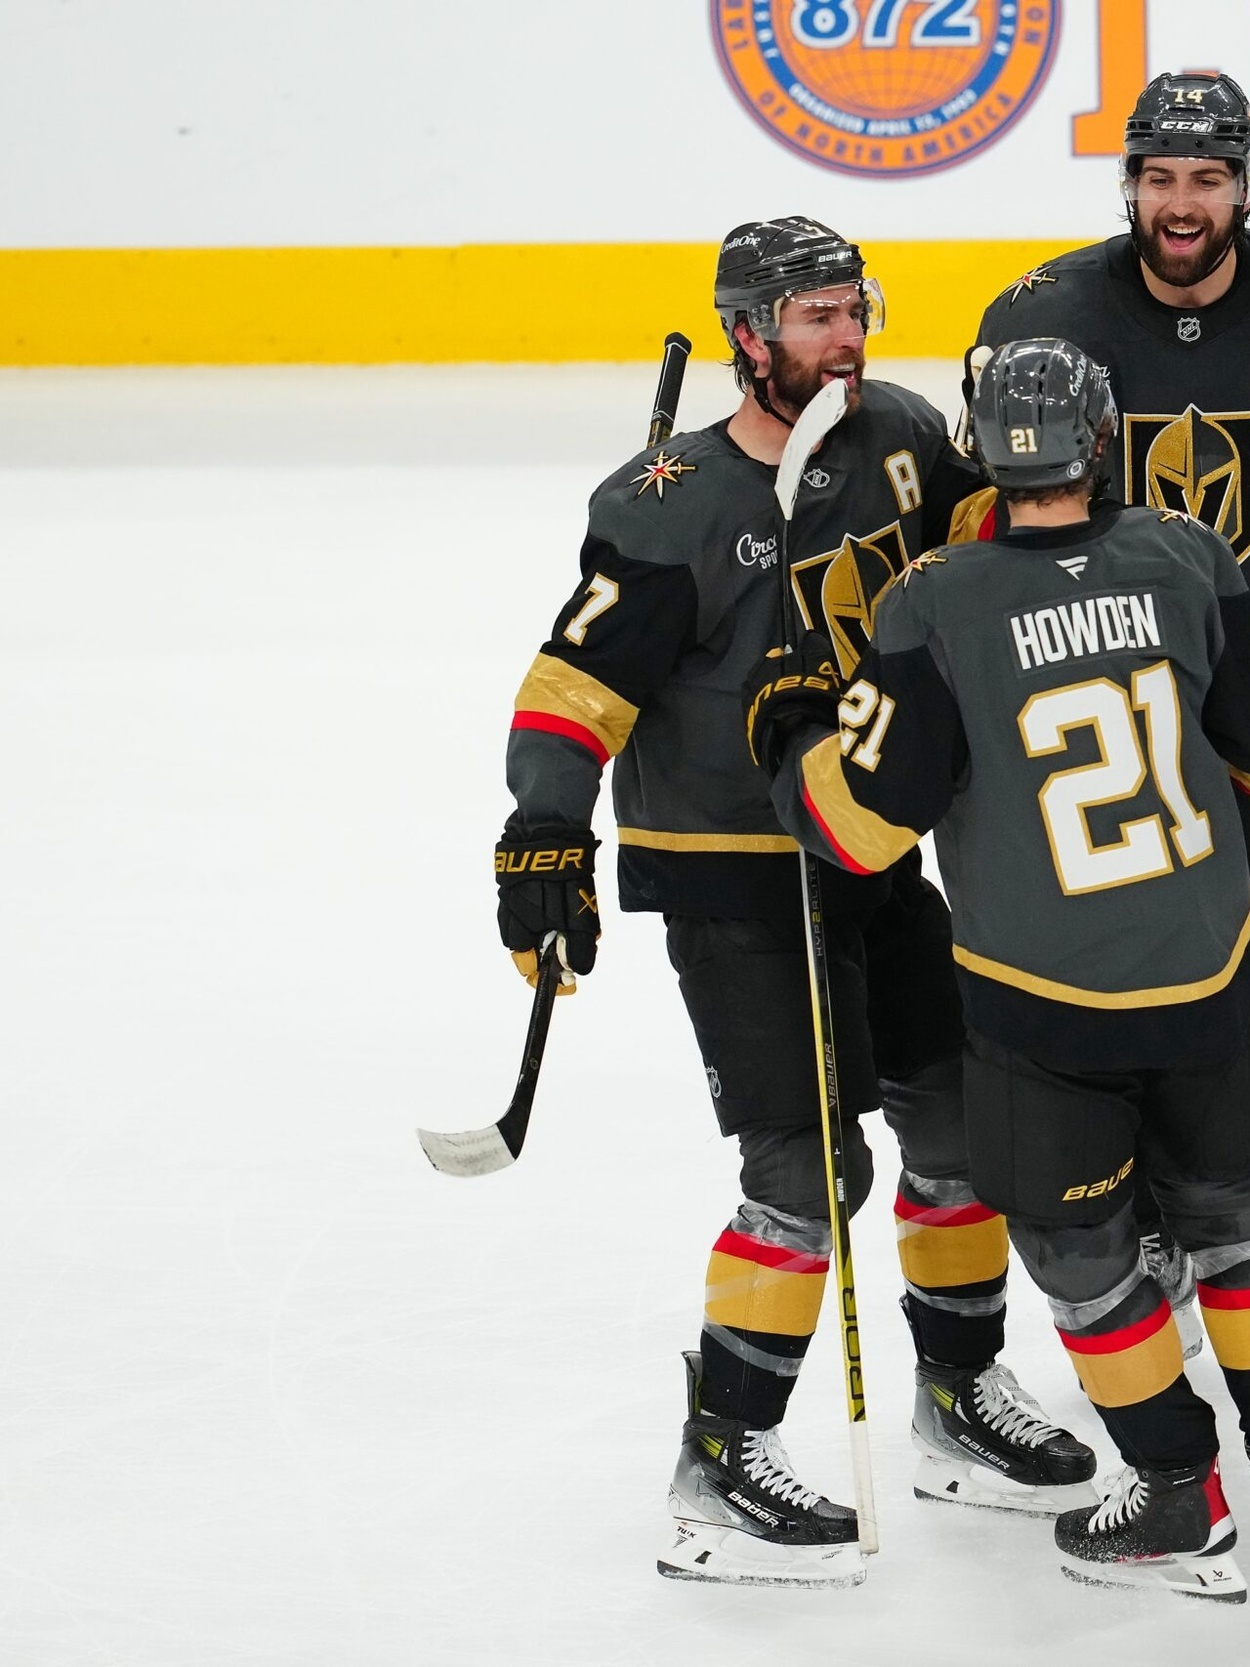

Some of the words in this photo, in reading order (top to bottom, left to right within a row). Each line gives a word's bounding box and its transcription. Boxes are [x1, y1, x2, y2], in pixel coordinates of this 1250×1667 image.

[1174, 88, 1204, 105] 14
[796, 122, 884, 163] NORTH
[902, 91, 1013, 163] AMERICA
[1160, 120, 1213, 133] CCM
[1010, 428, 1038, 454] 21
[884, 450, 922, 515] A
[563, 572, 619, 646] 7
[1011, 593, 1161, 671] HOWDEN
[837, 678, 896, 773] 21
[1017, 659, 1214, 897] 21
[494, 848, 584, 873] AUER
[1061, 1157, 1135, 1202] BAUE
[958, 1434, 1011, 1471] BAUER
[727, 1490, 780, 1529] BAUER
